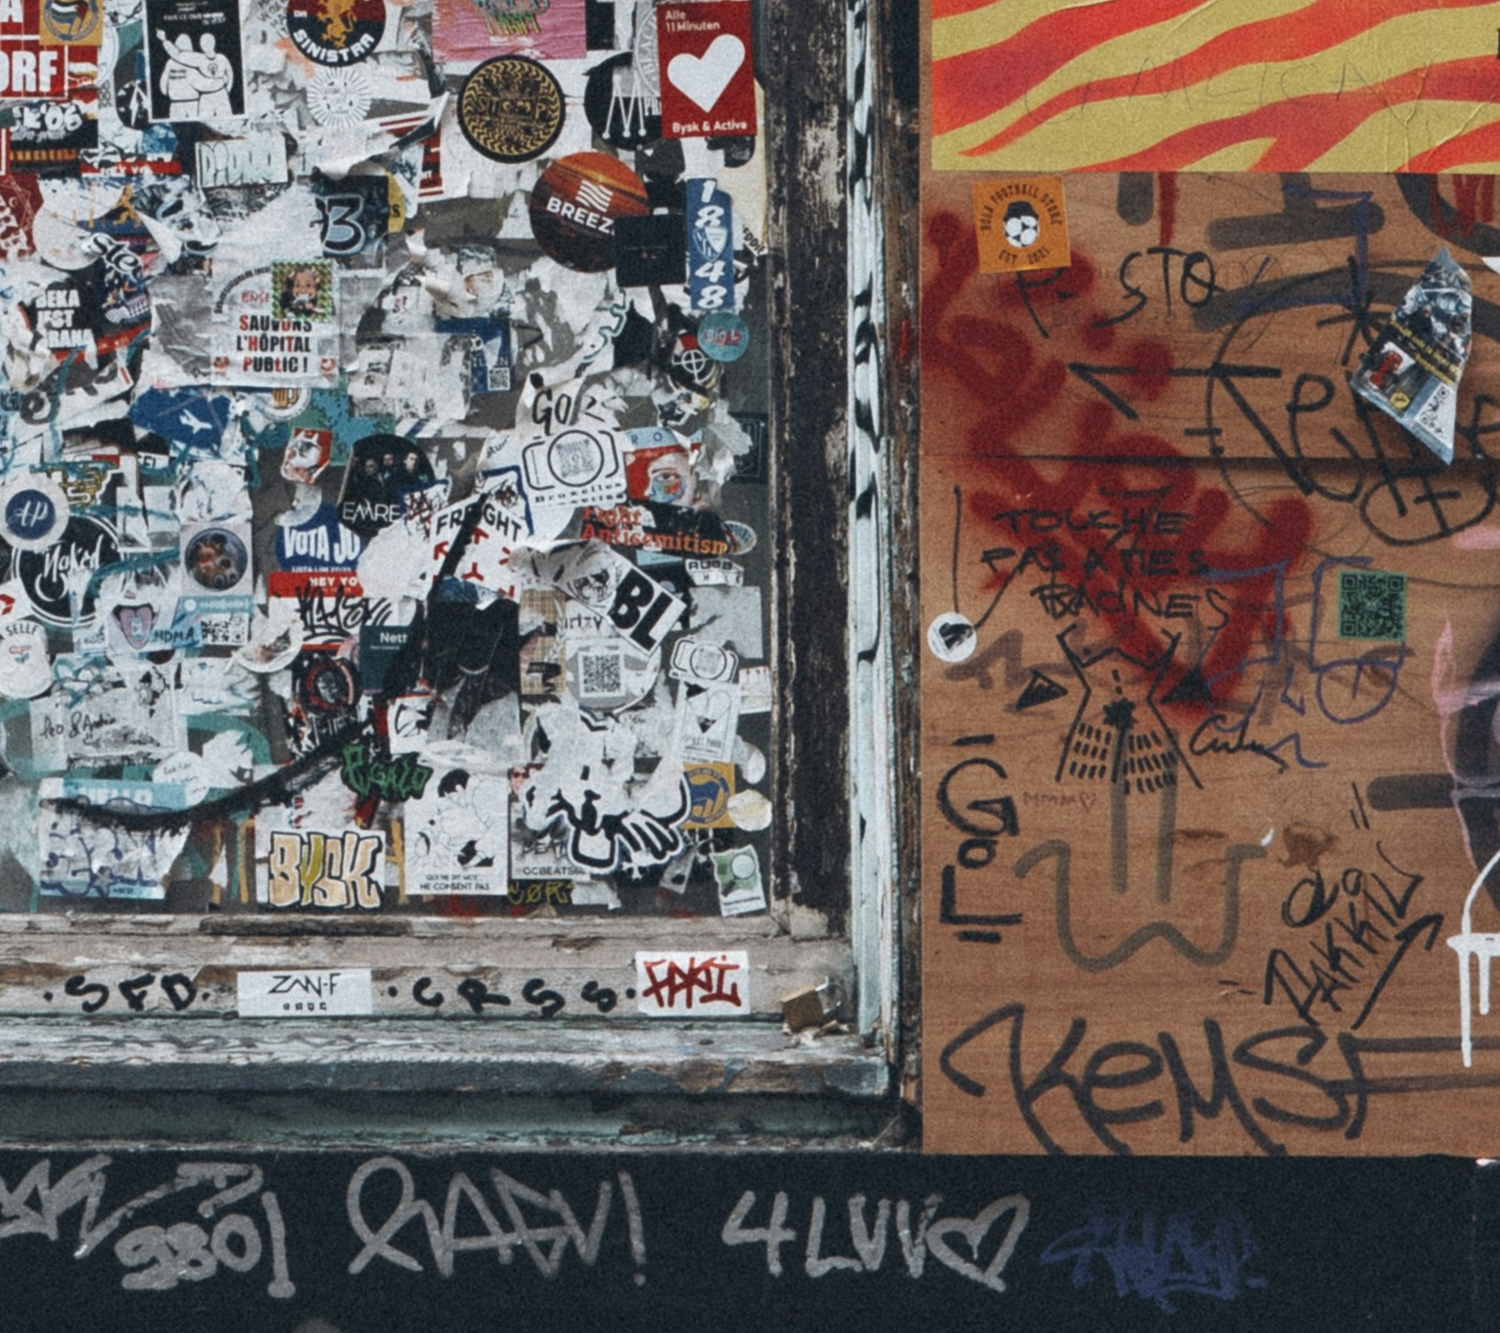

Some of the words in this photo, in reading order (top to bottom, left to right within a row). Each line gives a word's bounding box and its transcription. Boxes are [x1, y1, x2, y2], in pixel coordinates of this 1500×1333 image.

[292, 29, 375, 63] SINISTRA
[236, 334, 312, 353] L'HÔPITAL
[580, 526, 729, 555] Antisemitism
